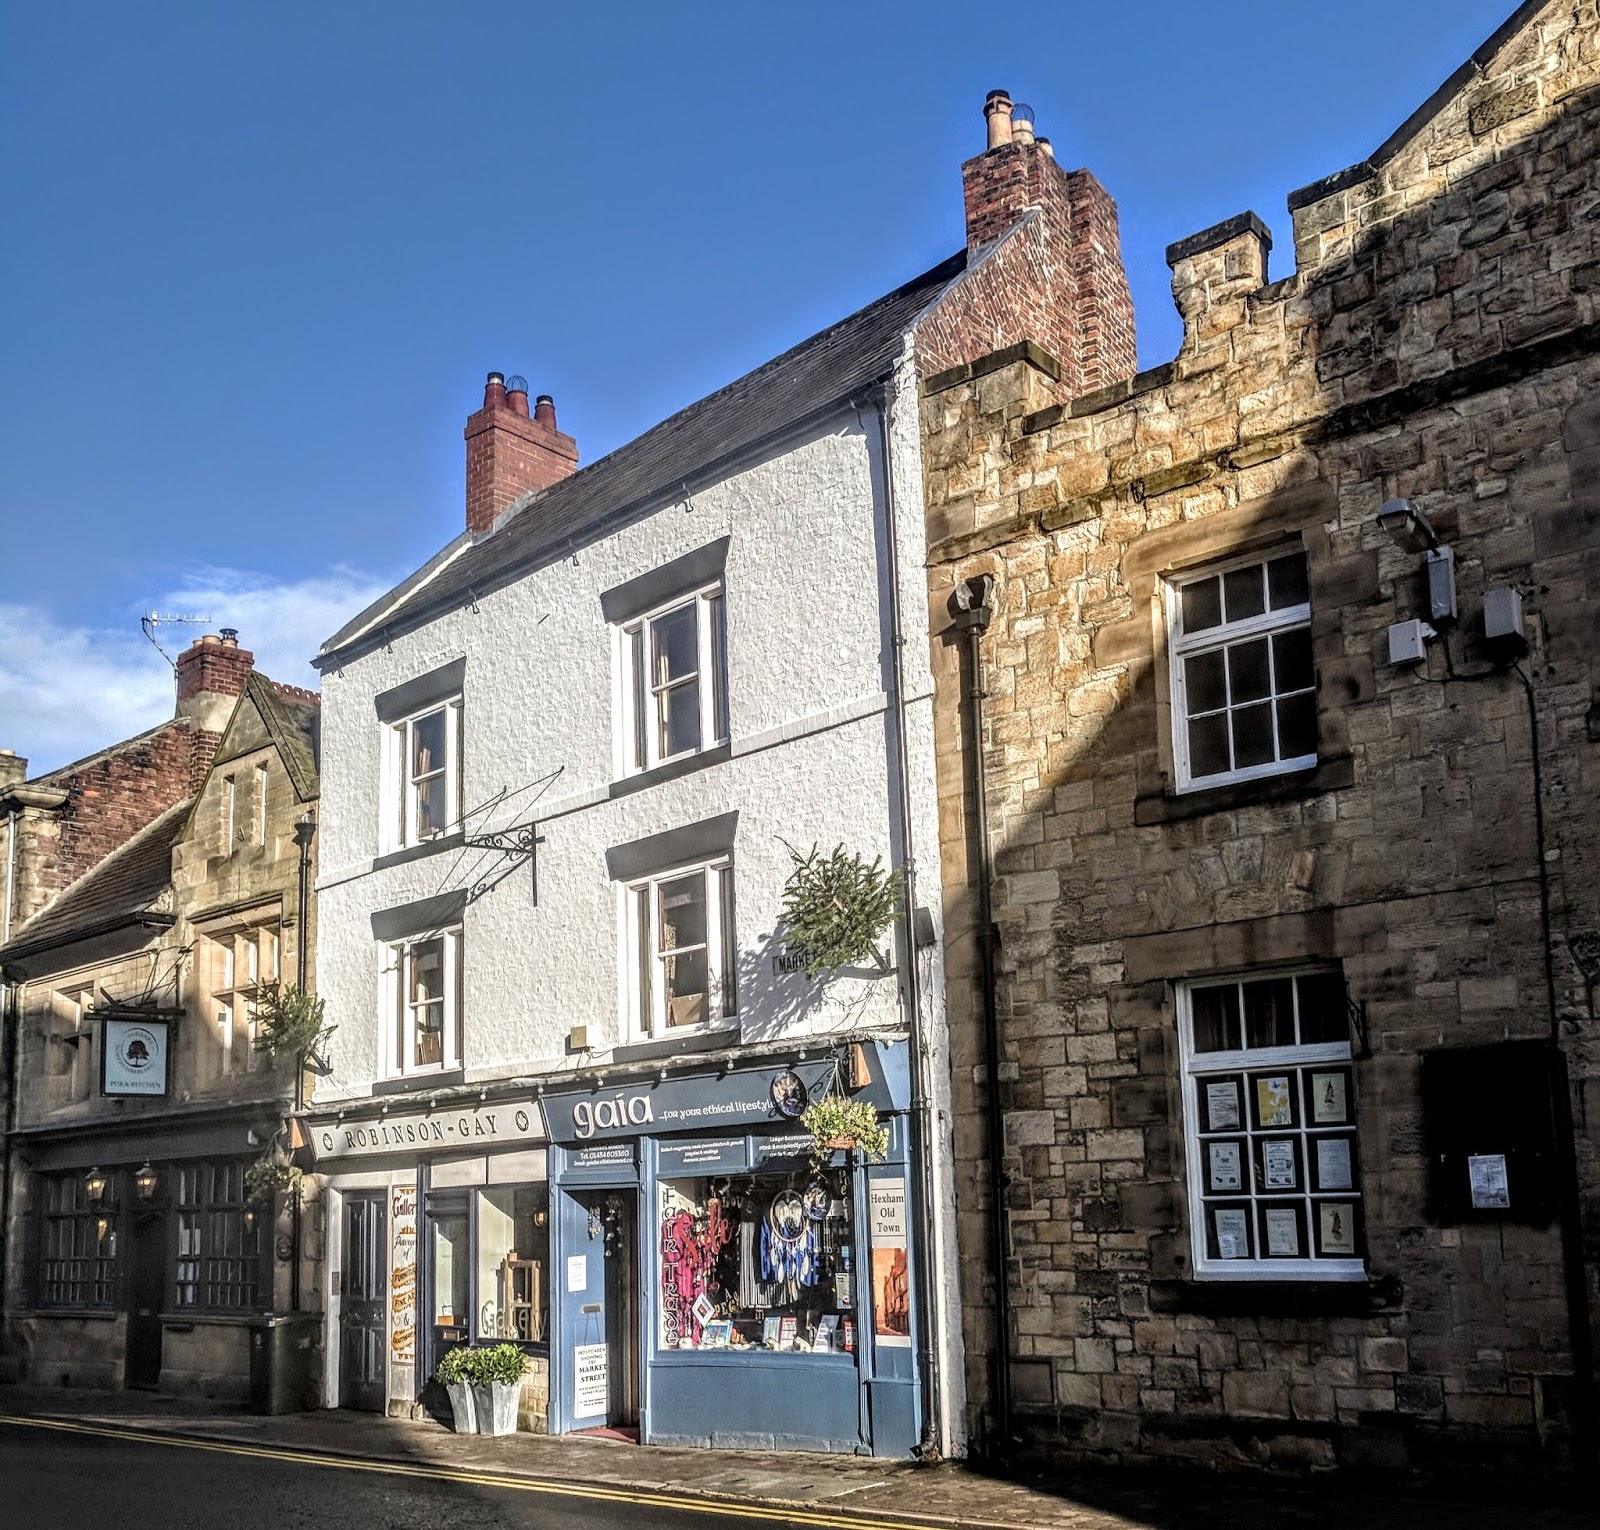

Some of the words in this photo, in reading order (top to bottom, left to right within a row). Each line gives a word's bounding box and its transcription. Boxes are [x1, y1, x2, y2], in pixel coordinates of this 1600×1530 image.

[779, 951, 816, 971] MARKET
[680, 1108, 702, 1119] your
[702, 1102, 735, 1115] ethical
[345, 1115, 498, 1148] ROBINSON-GAY
[871, 1193, 904, 1203] Hexham
[392, 1196, 416, 1218] Galler
[880, 1207, 895, 1217] Old
[876, 1222, 900, 1232] Town
[394, 1268, 415, 1281] FURNITU
[394, 1297, 407, 1306] FINE
[407, 1292, 415, 1302] AR
[403, 1312, 410, 1326] &
[578, 1347, 606, 1355] INDEPENDEN
[579, 1363, 608, 1373] MARKET
[580, 1373, 607, 1383] STREET
